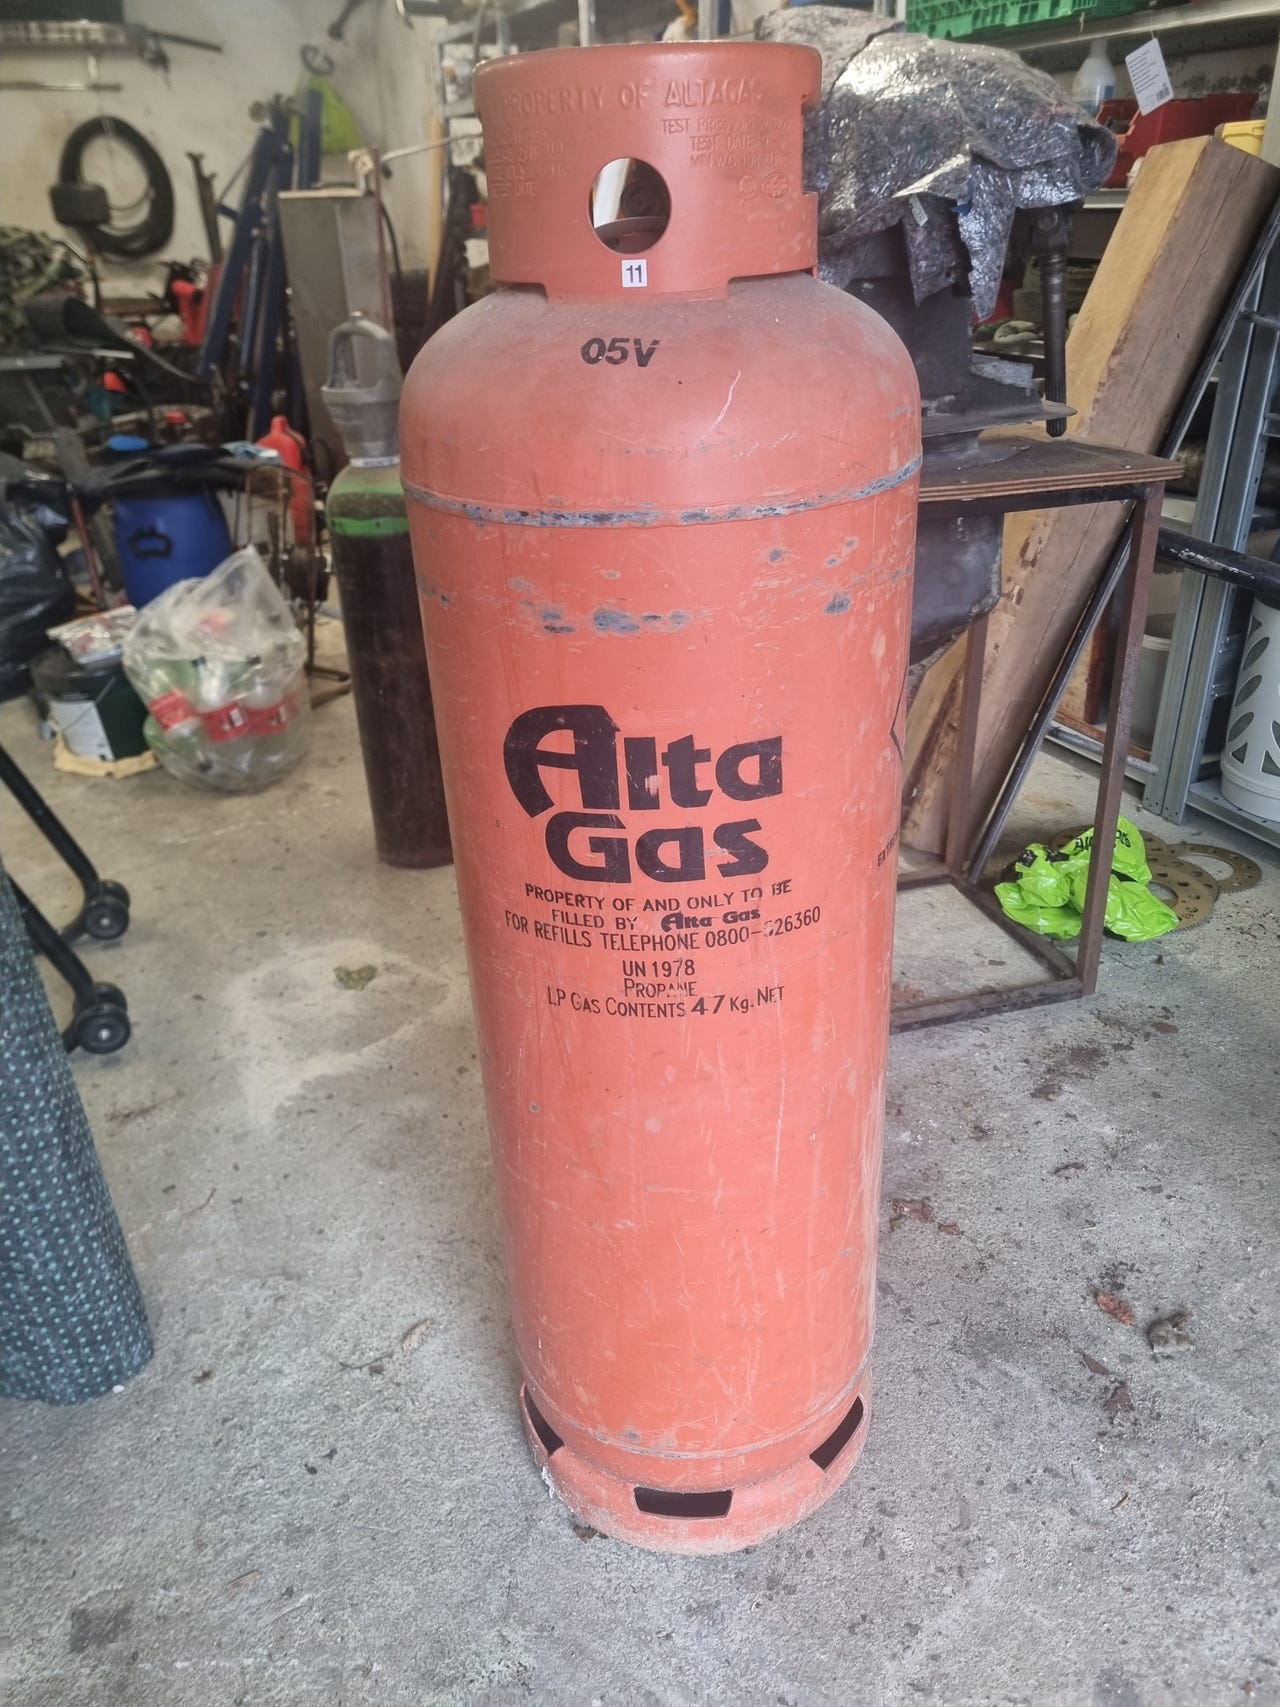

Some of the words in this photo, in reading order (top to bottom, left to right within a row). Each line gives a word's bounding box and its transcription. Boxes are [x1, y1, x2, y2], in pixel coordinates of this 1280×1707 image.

[503, 83, 605, 118] PROPERTY
[618, 80, 650, 110] OF
[660, 117, 690, 134] TEST
[689, 134, 722, 151] TEST
[625, 264, 643, 284] 11
[580, 337, 660, 368] 05V
[503, 704, 783, 818] Alta
[545, 811, 769, 884] Gas
[525, 883, 605, 909] PROPERTY
[612, 898, 635, 911] OF
[642, 898, 680, 912] AND
[687, 891, 735, 910] ONLY
[741, 886, 763, 903] TO
[771, 878, 793, 896] BE
[505, 909, 529, 934] FOR
[534, 920, 592, 947] REFILLS
[600, 932, 700, 951] TELEPHONE
[552, 908, 605, 929] FILLED
[615, 916, 638, 930] BY
[722, 907, 761, 925] Gas
[622, 960, 647, 977] UN
[651, 958, 695, 978] 1978
[547, 986, 567, 1007] LP
[570, 991, 601, 1015] GAS
[605, 997, 686, 1018] CONTENTS
[690, 994, 726, 1017] 47
[757, 986, 784, 1007] NET
